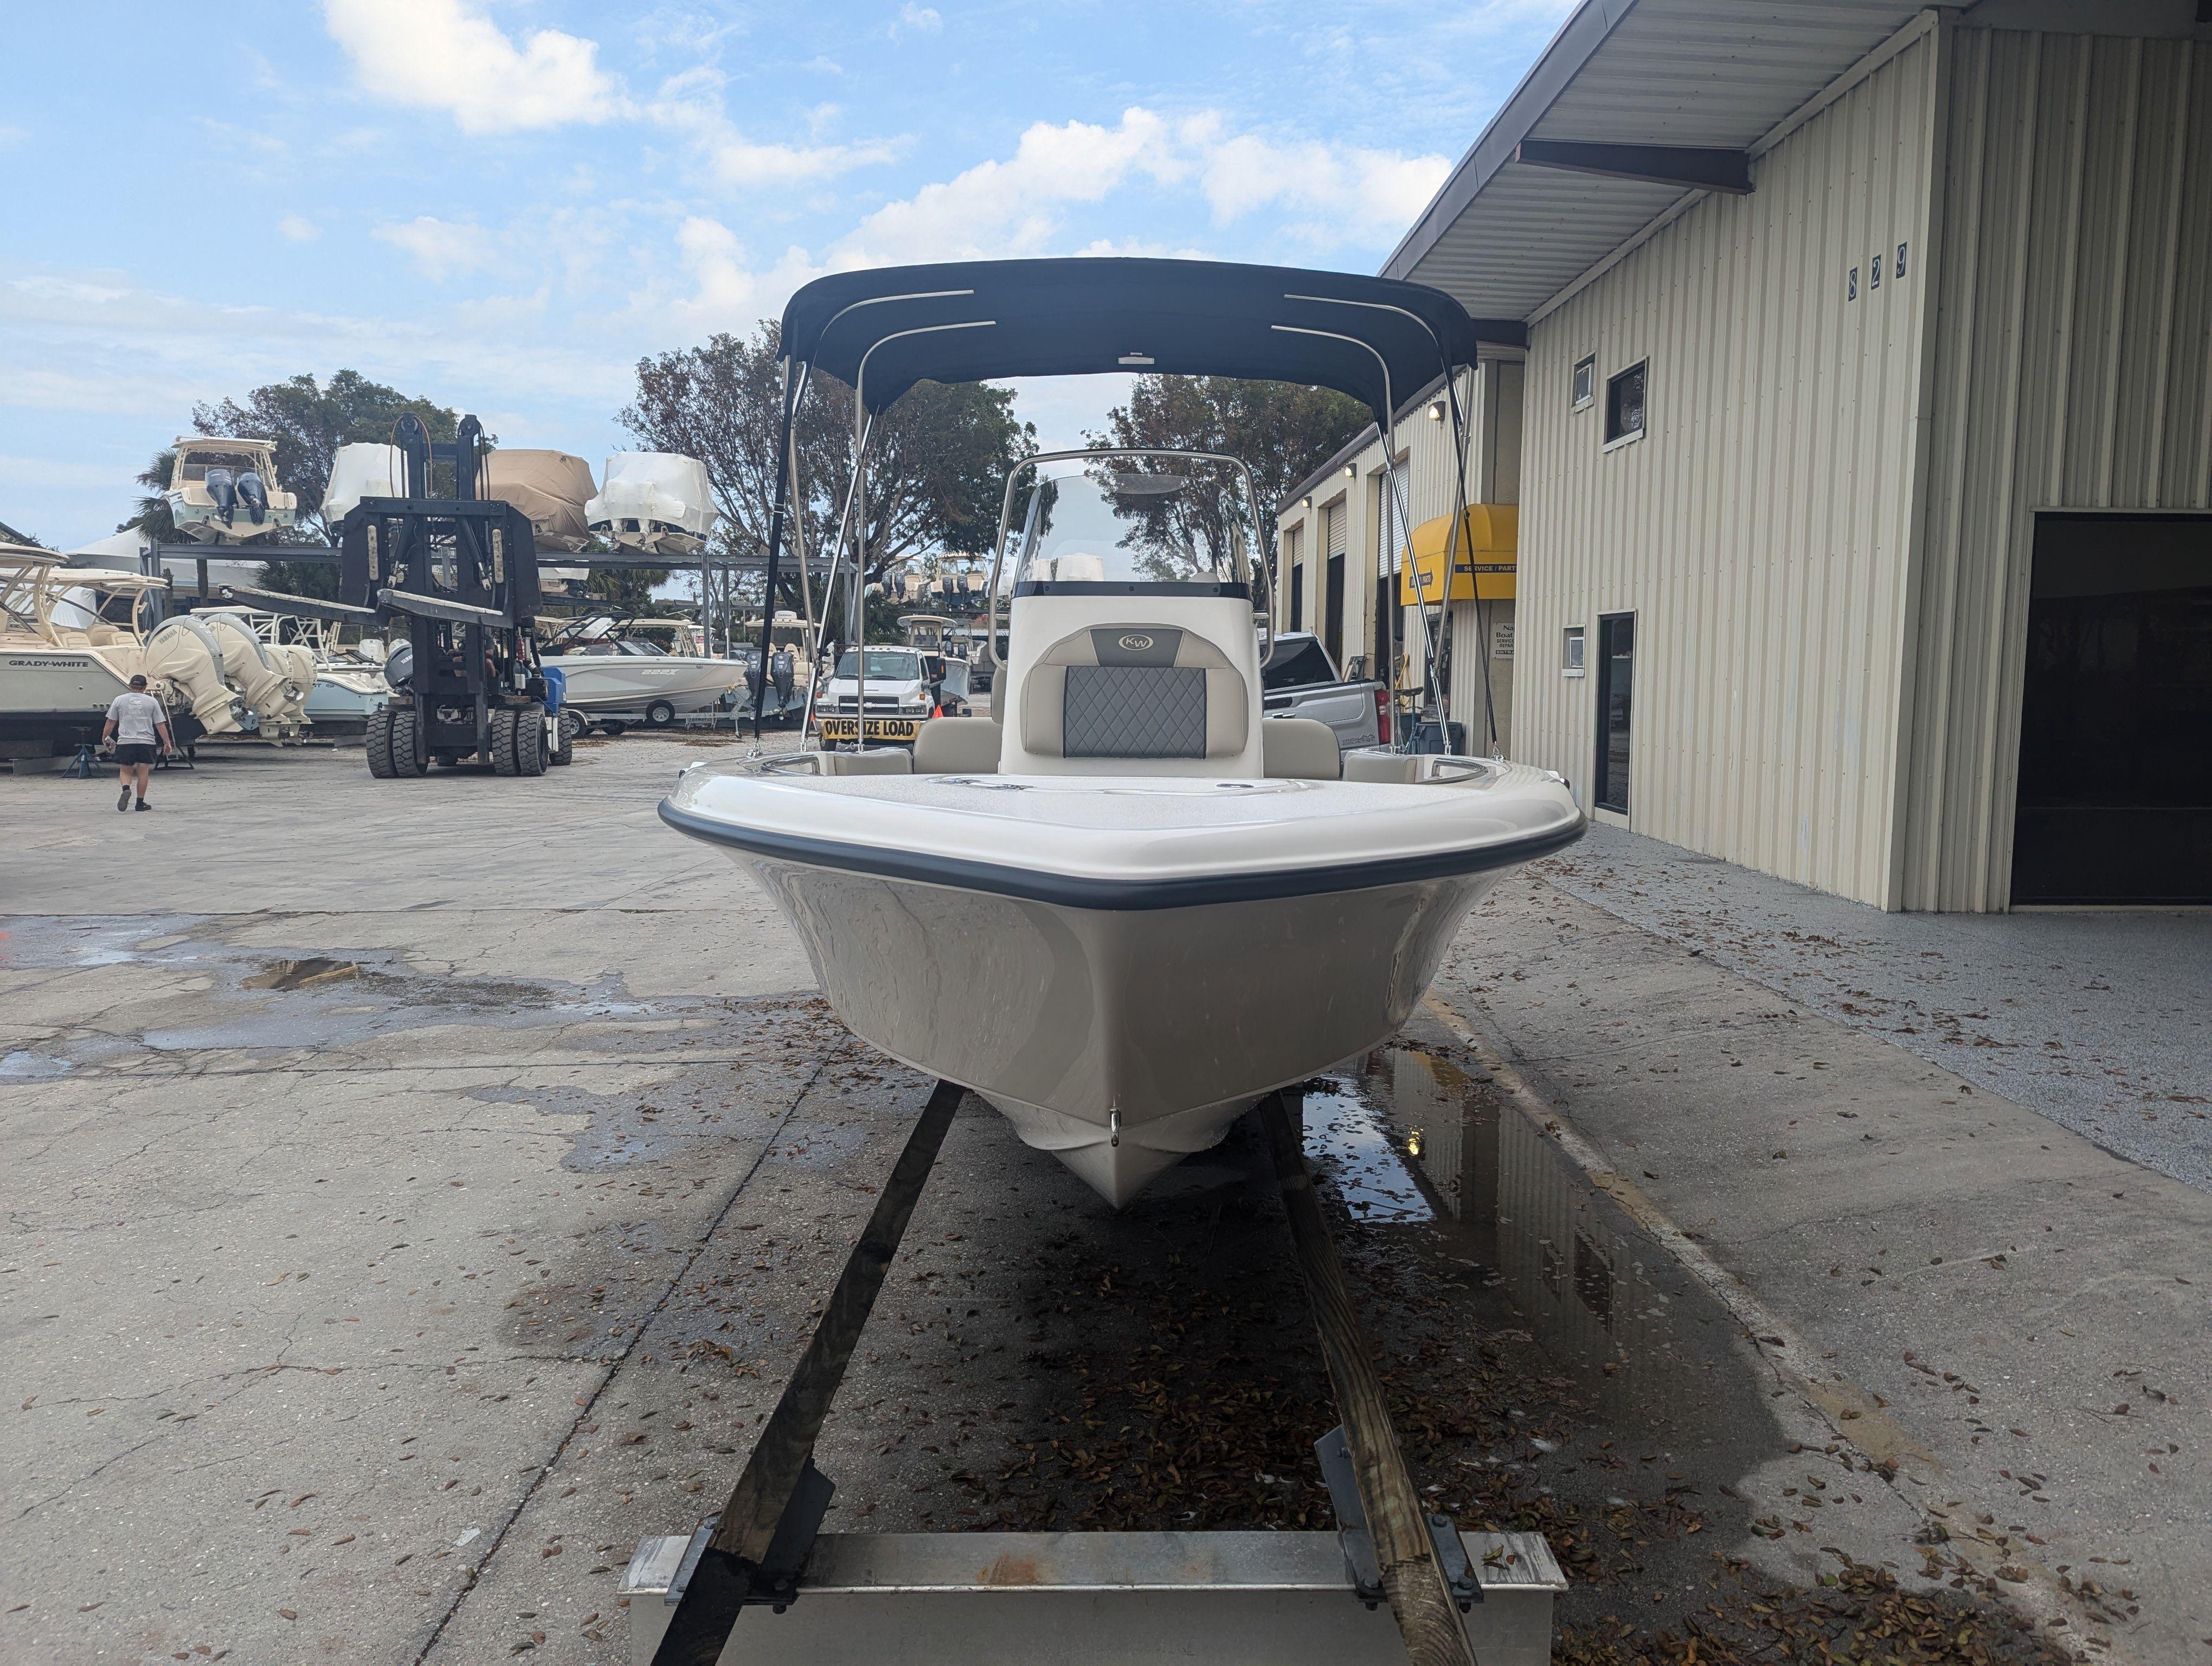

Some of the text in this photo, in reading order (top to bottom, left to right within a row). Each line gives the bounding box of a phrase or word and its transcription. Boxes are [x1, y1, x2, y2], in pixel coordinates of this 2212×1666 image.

[158, 629, 178, 644] YAMAHA
[1126, 637, 1148, 647] KW
[883, 721, 914, 736] LOAD
